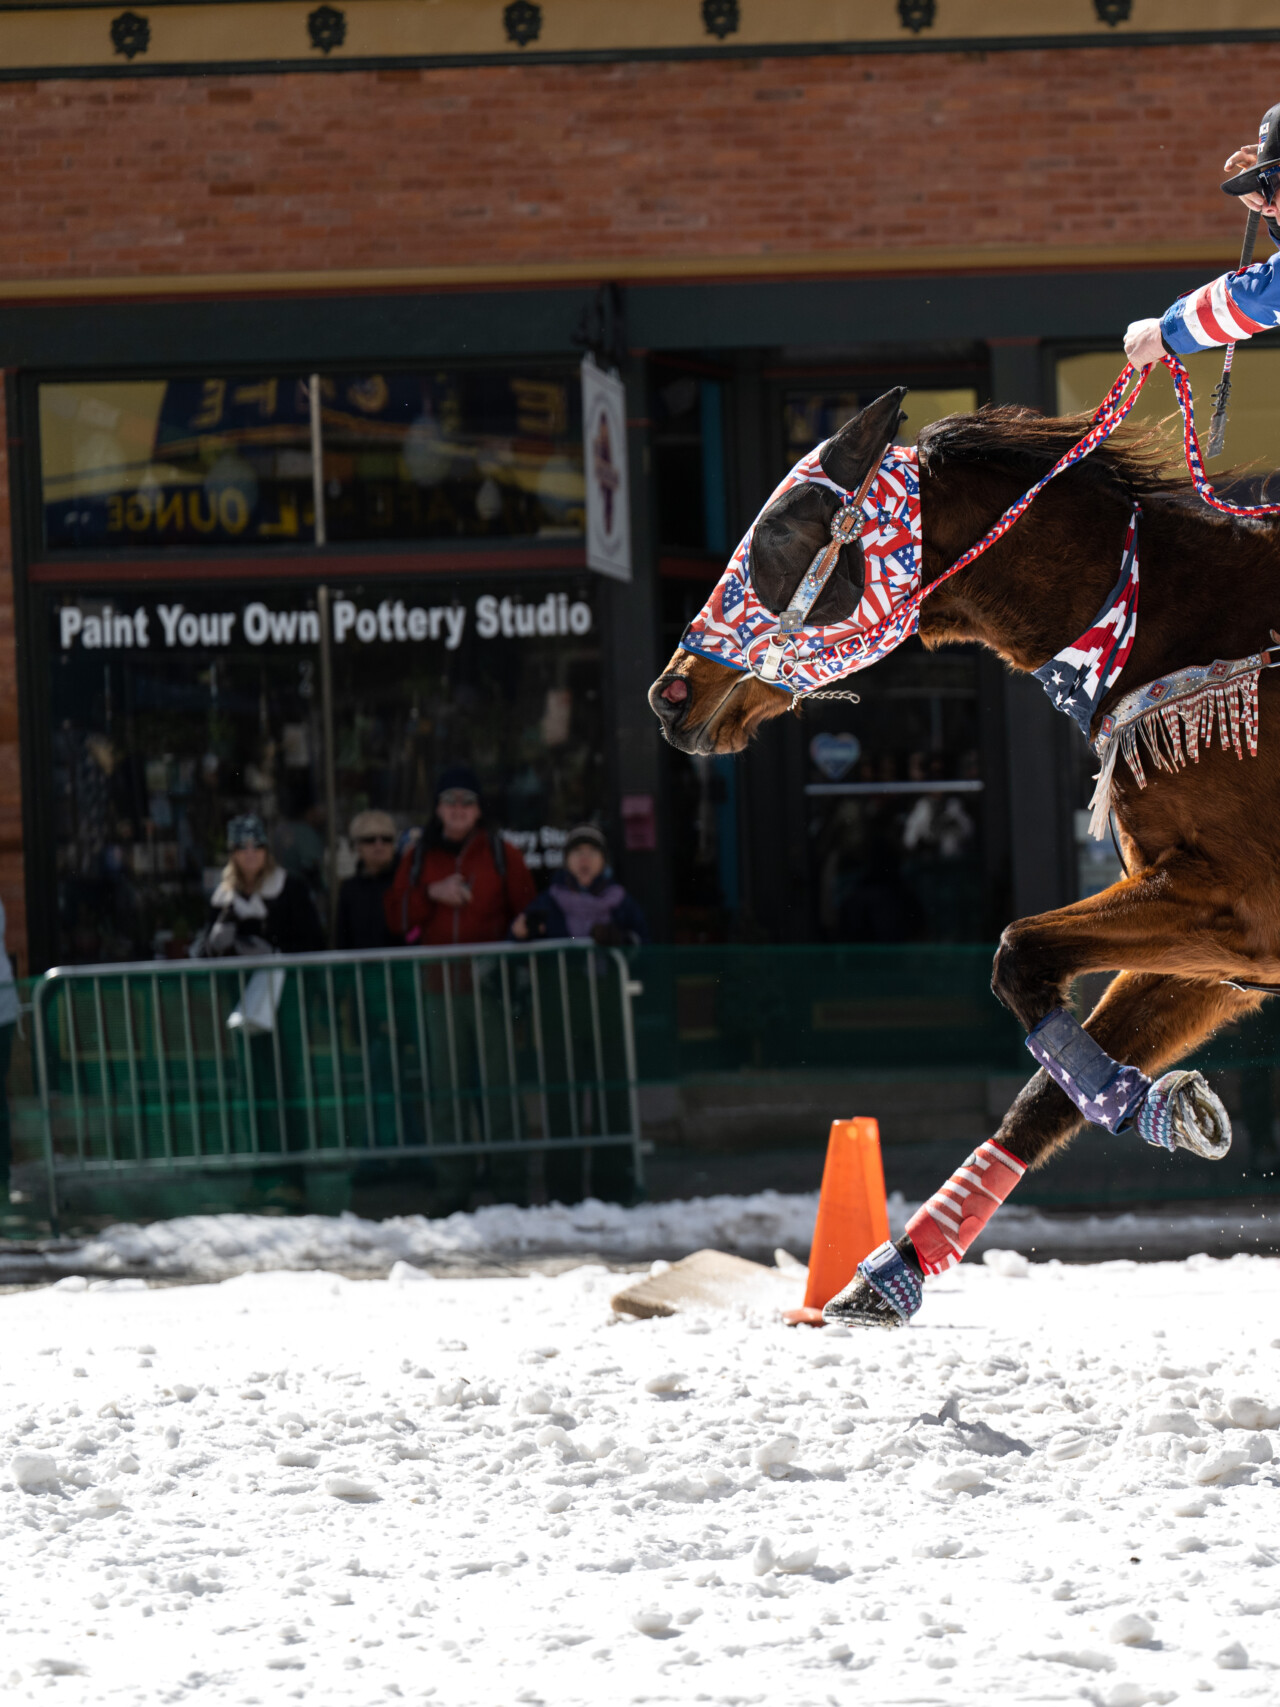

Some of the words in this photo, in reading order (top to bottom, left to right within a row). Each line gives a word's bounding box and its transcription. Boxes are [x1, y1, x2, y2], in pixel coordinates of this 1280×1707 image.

[59, 604, 150, 650] Paint
[156, 602, 237, 648] Your
[243, 601, 321, 646] Own
[333, 597, 466, 651] Pottery
[475, 592, 592, 640] Studio
